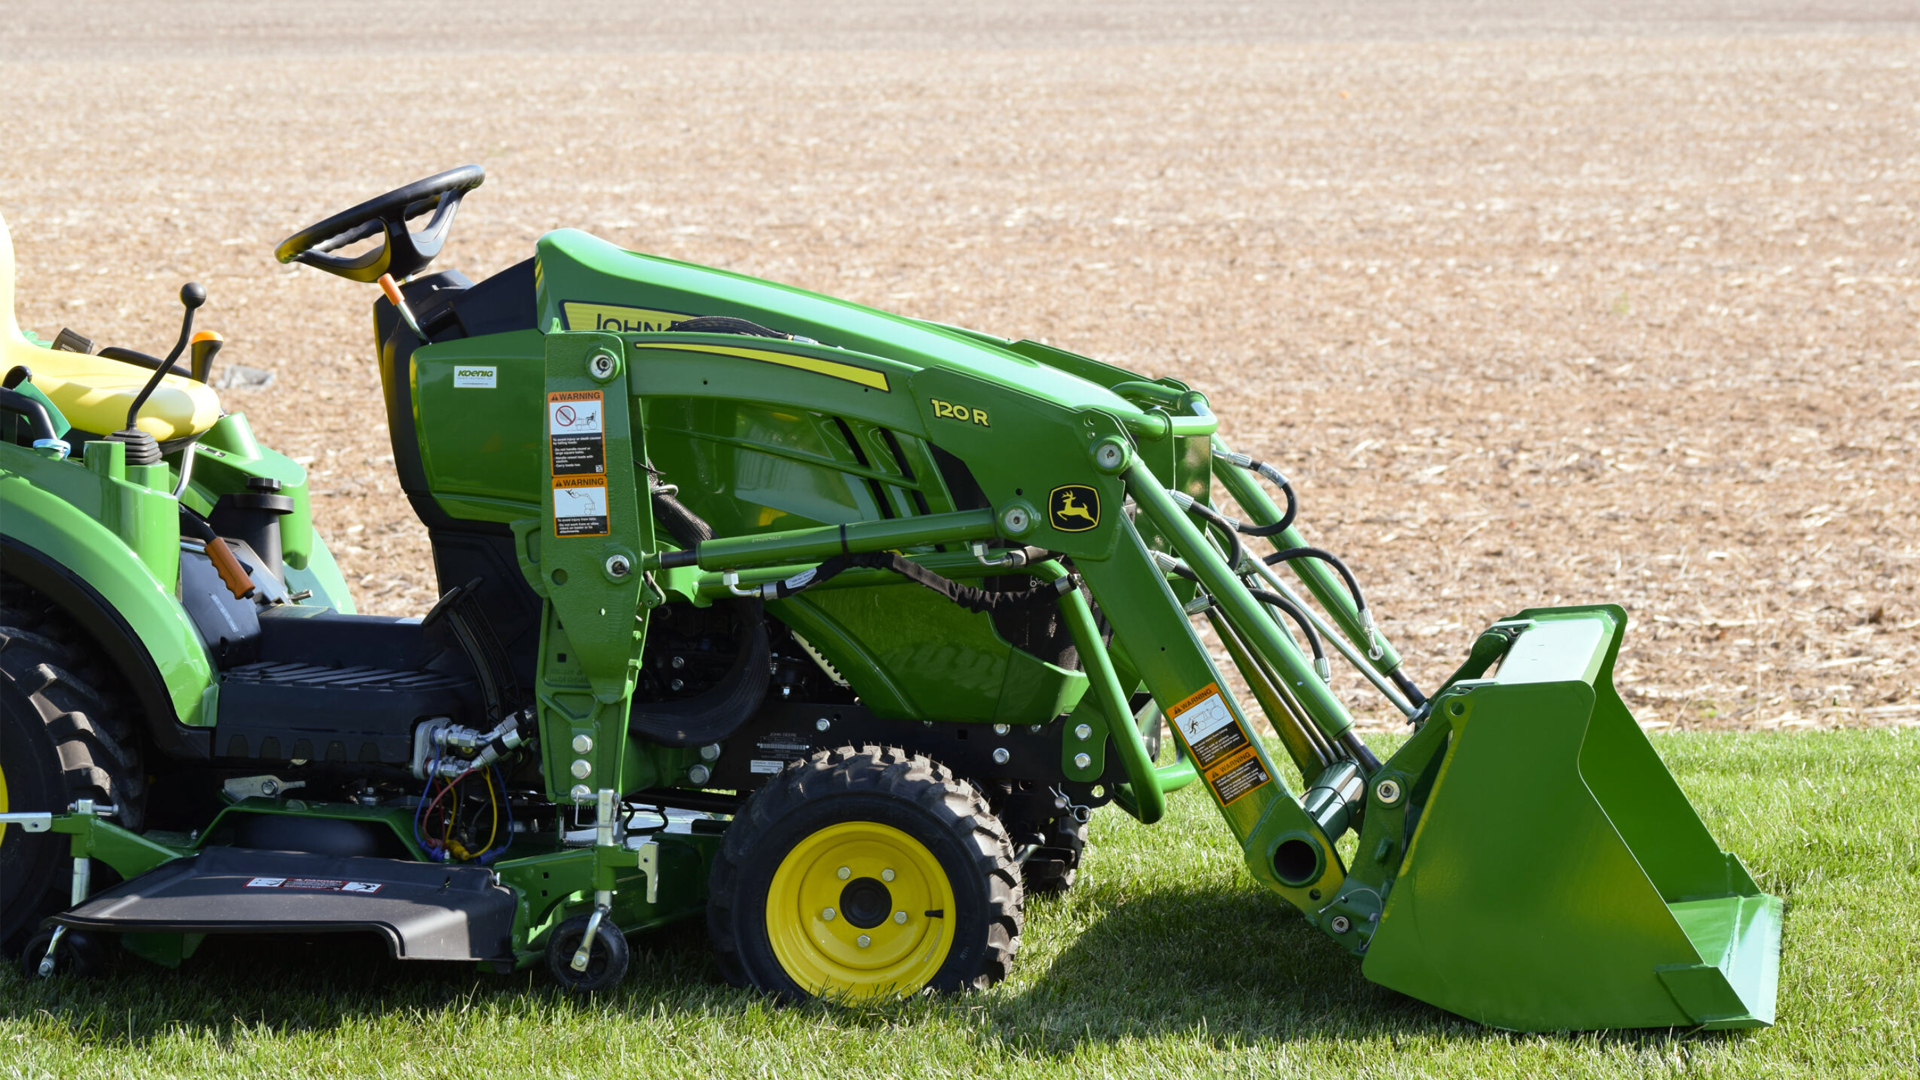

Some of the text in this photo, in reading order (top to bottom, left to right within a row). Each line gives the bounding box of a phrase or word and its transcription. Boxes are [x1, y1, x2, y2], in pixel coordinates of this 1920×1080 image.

[559, 392, 601, 400] WARNING
[930, 398, 991, 427] 120 R
[563, 478, 604, 486] WARNING
[1181, 688, 1212, 710] WARNING
[1220, 752, 1250, 773] WARNING
